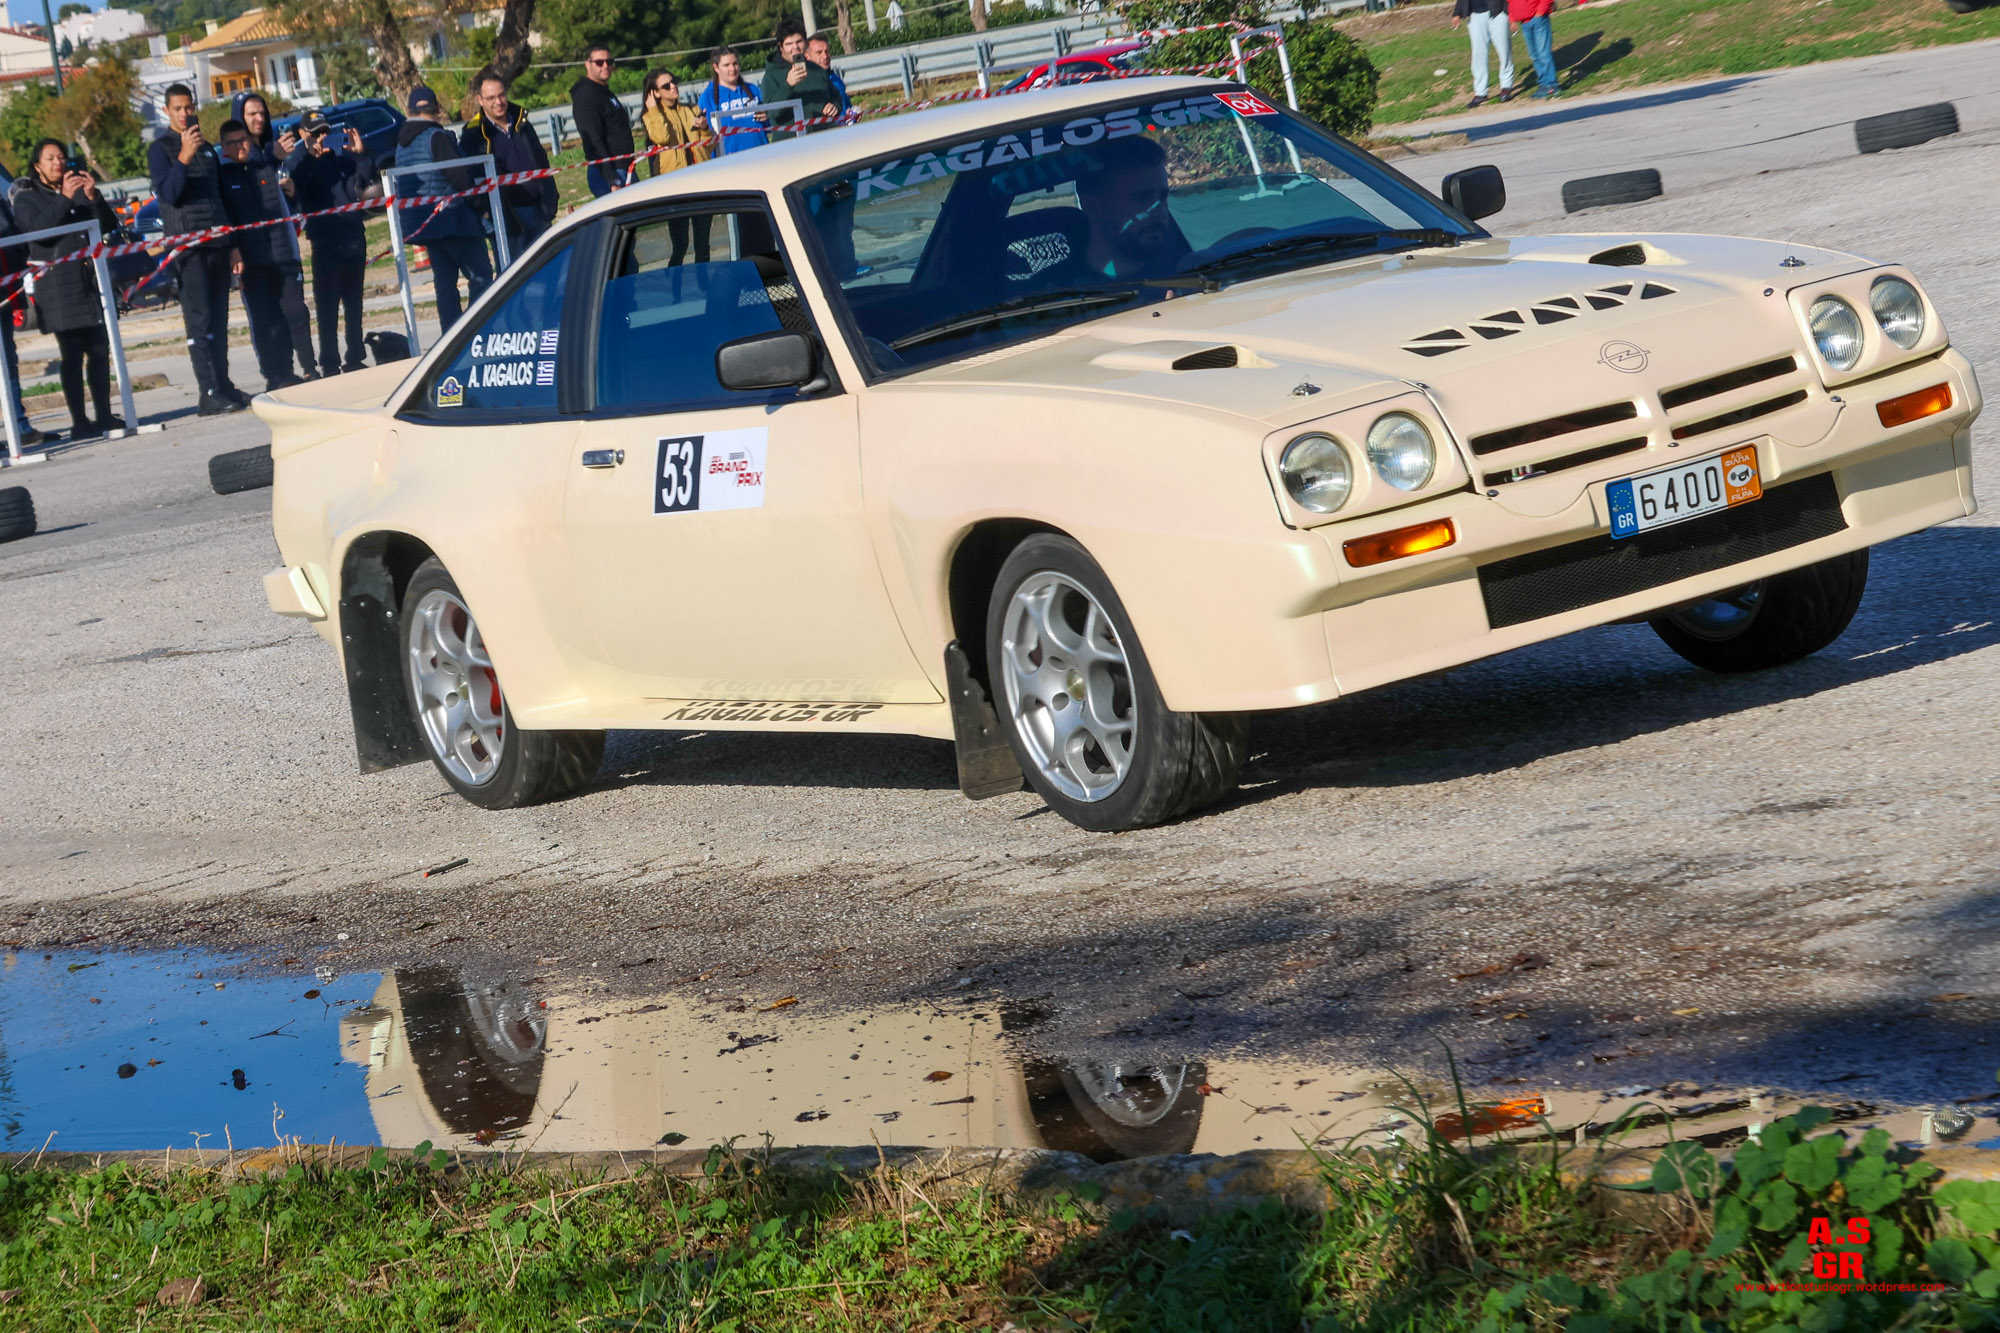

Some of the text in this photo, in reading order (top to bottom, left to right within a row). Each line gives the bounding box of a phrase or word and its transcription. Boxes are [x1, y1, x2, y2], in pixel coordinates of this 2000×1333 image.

[855, 97, 1226, 201] KAGALOS.GR
[471, 331, 537, 358] G. KAGALOS
[467, 361, 534, 388] A. KAGALOS
[662, 440, 694, 507] 53
[709, 460, 748, 474] GRAND
[736, 472, 763, 487] PRIX
[1639, 465, 1721, 521] 6400
[1618, 512, 1635, 529] GR
